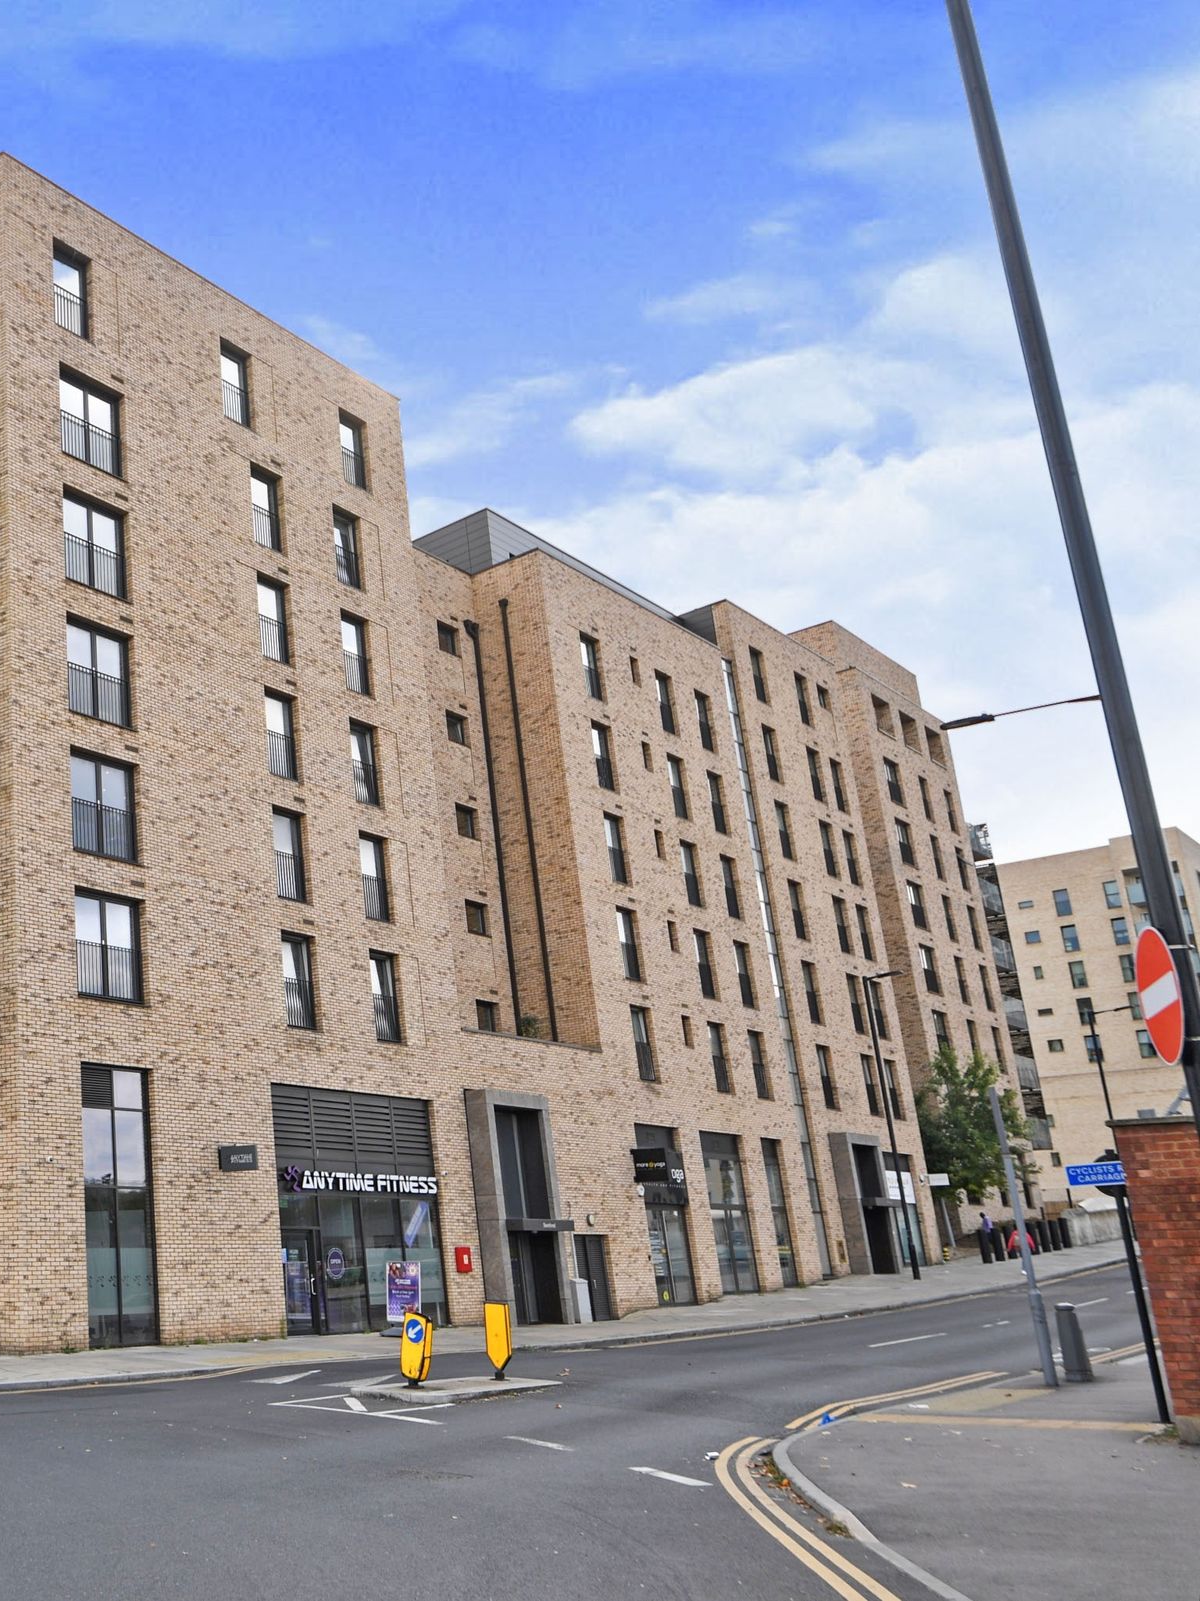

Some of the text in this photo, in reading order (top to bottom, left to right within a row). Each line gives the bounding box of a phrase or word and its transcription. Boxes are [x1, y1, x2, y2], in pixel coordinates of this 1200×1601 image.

[671, 1168, 685, 1183] oga
[1068, 1165, 1114, 1176] CYCLISTS
[302, 1170, 438, 1194] ANYTIME FITNESS
